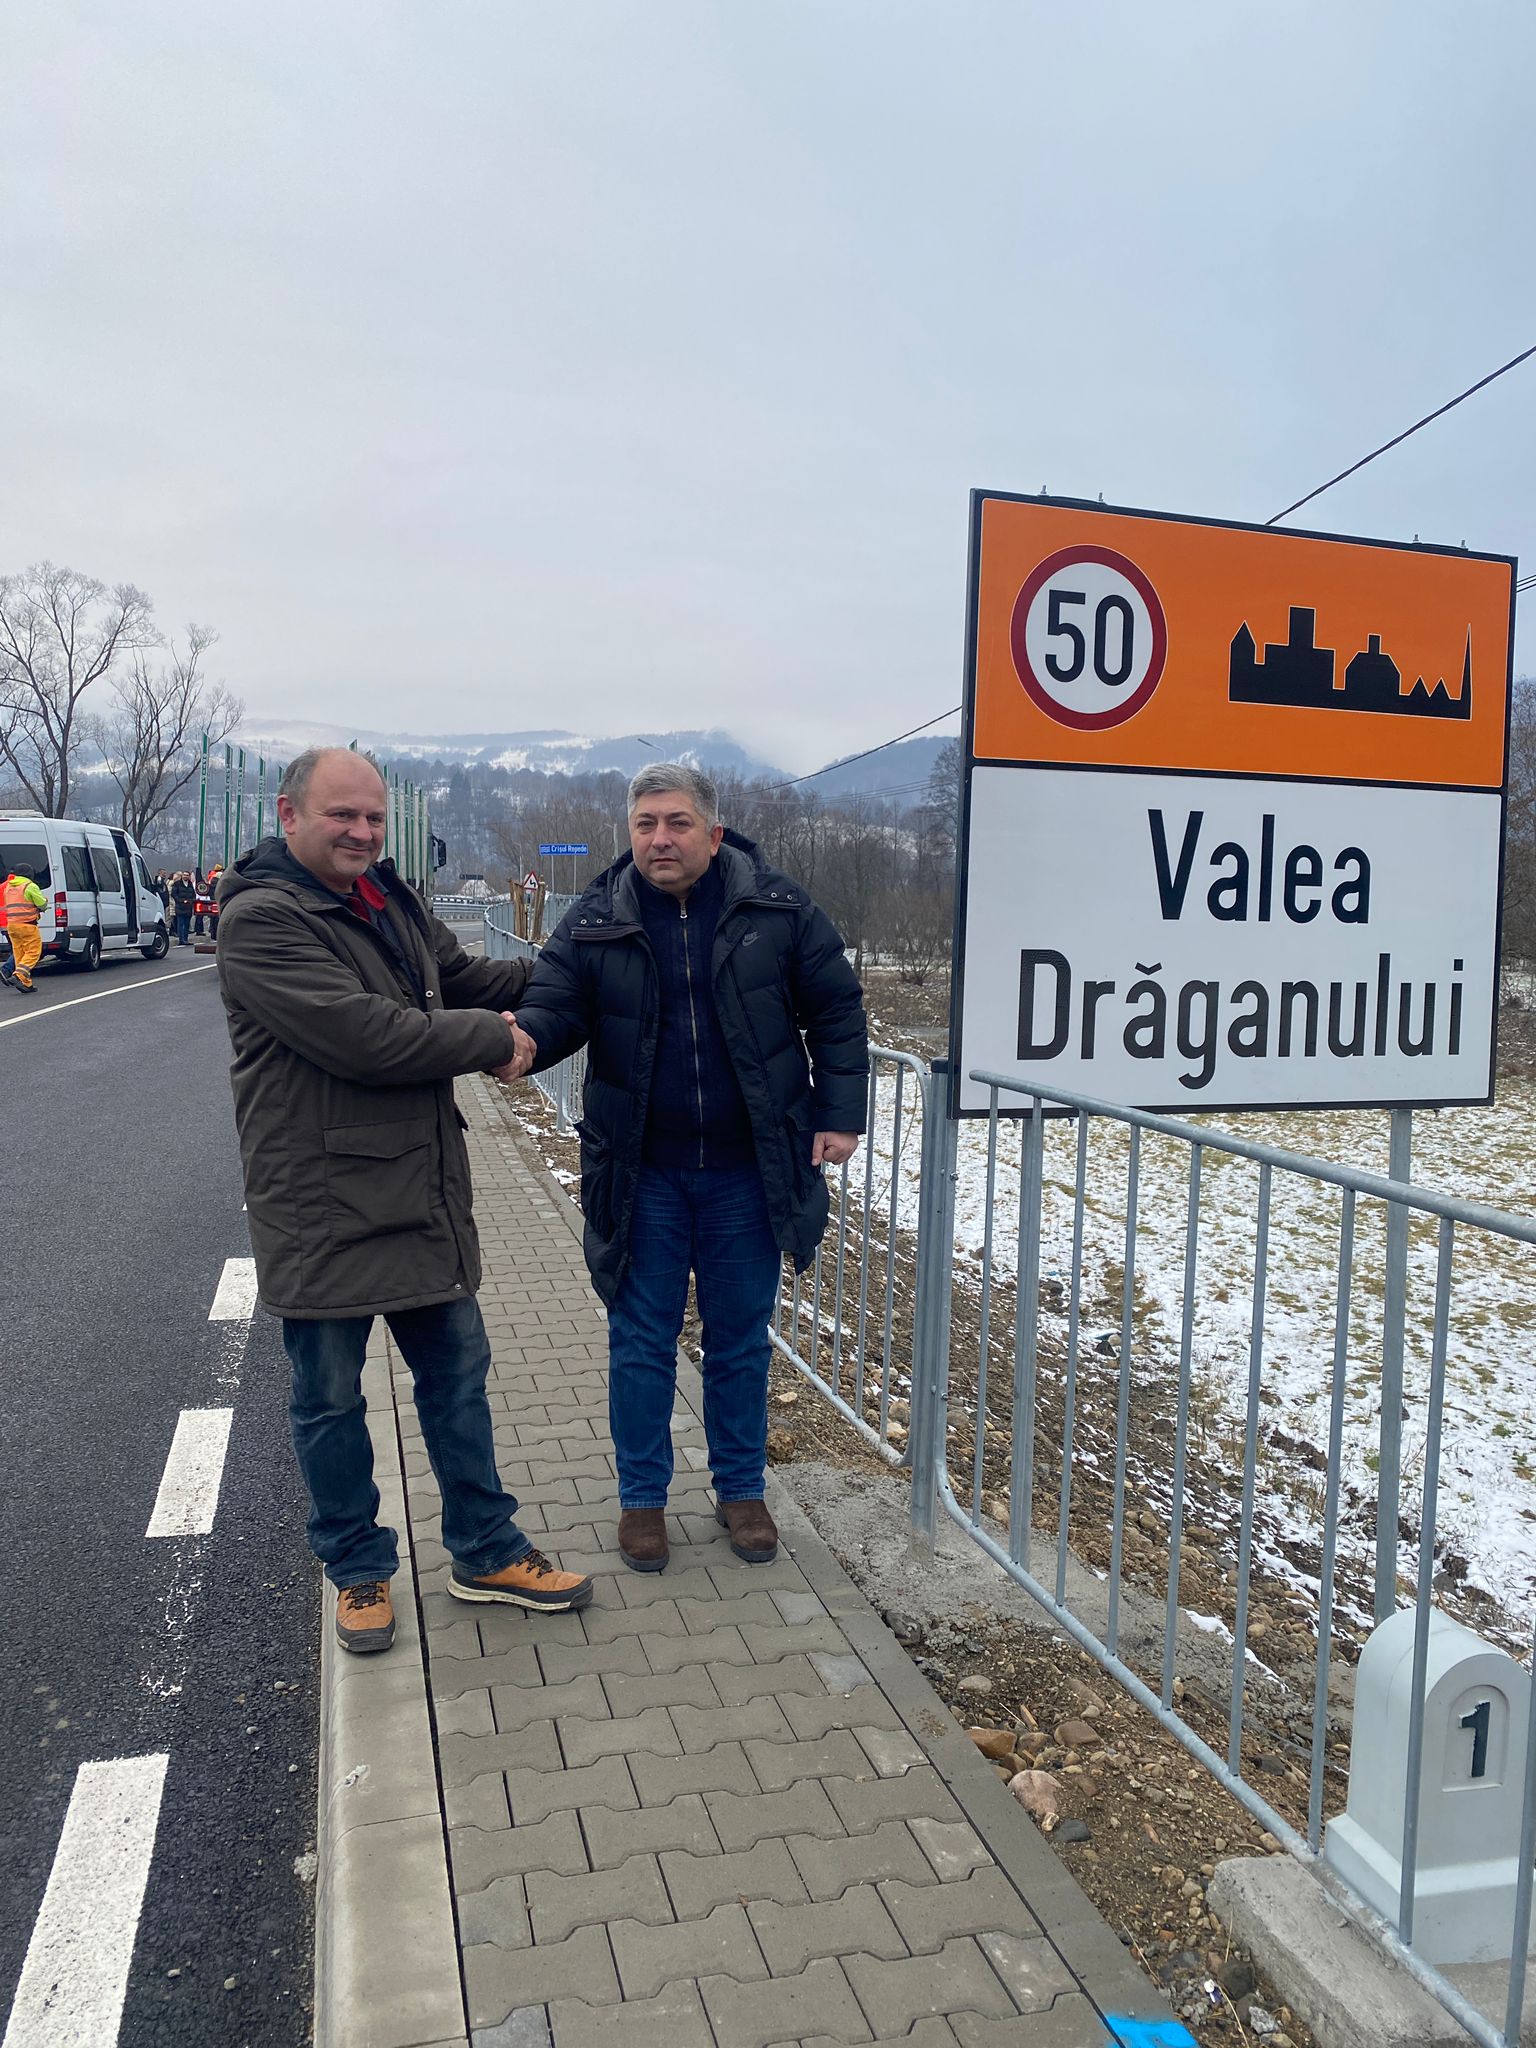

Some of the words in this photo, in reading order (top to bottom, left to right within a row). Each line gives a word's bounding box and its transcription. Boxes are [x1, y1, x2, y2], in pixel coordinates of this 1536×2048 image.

[1044, 589, 1135, 687] 50
[568, 845, 587, 854] Repede
[1147, 808, 1371, 924] Valea
[1016, 948, 1464, 1090] Drăganului
[1457, 1701, 1491, 1779] 1
